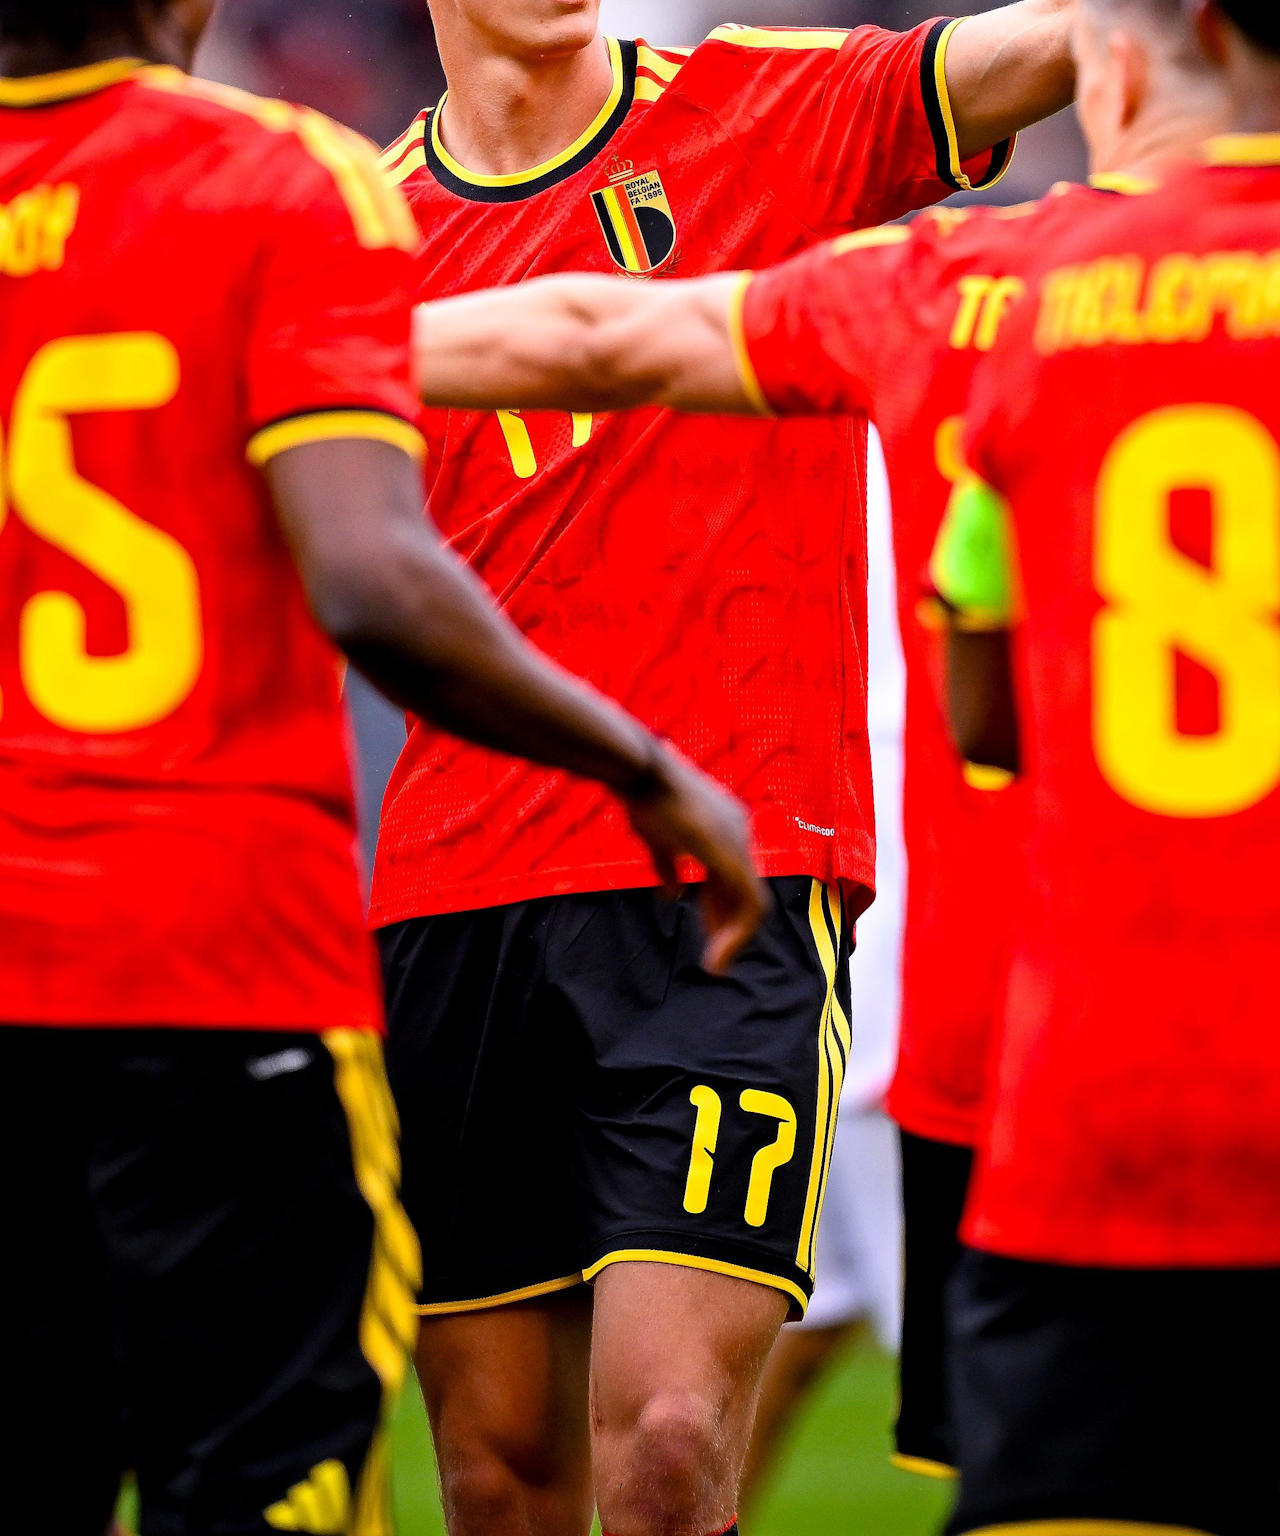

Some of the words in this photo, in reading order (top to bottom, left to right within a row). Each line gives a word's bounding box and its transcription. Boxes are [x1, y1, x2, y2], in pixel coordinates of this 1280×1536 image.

[624, 176, 650, 190] ROYAL
[627, 181, 661, 199] BELGIAN
[683, 1084, 797, 1227] 17
